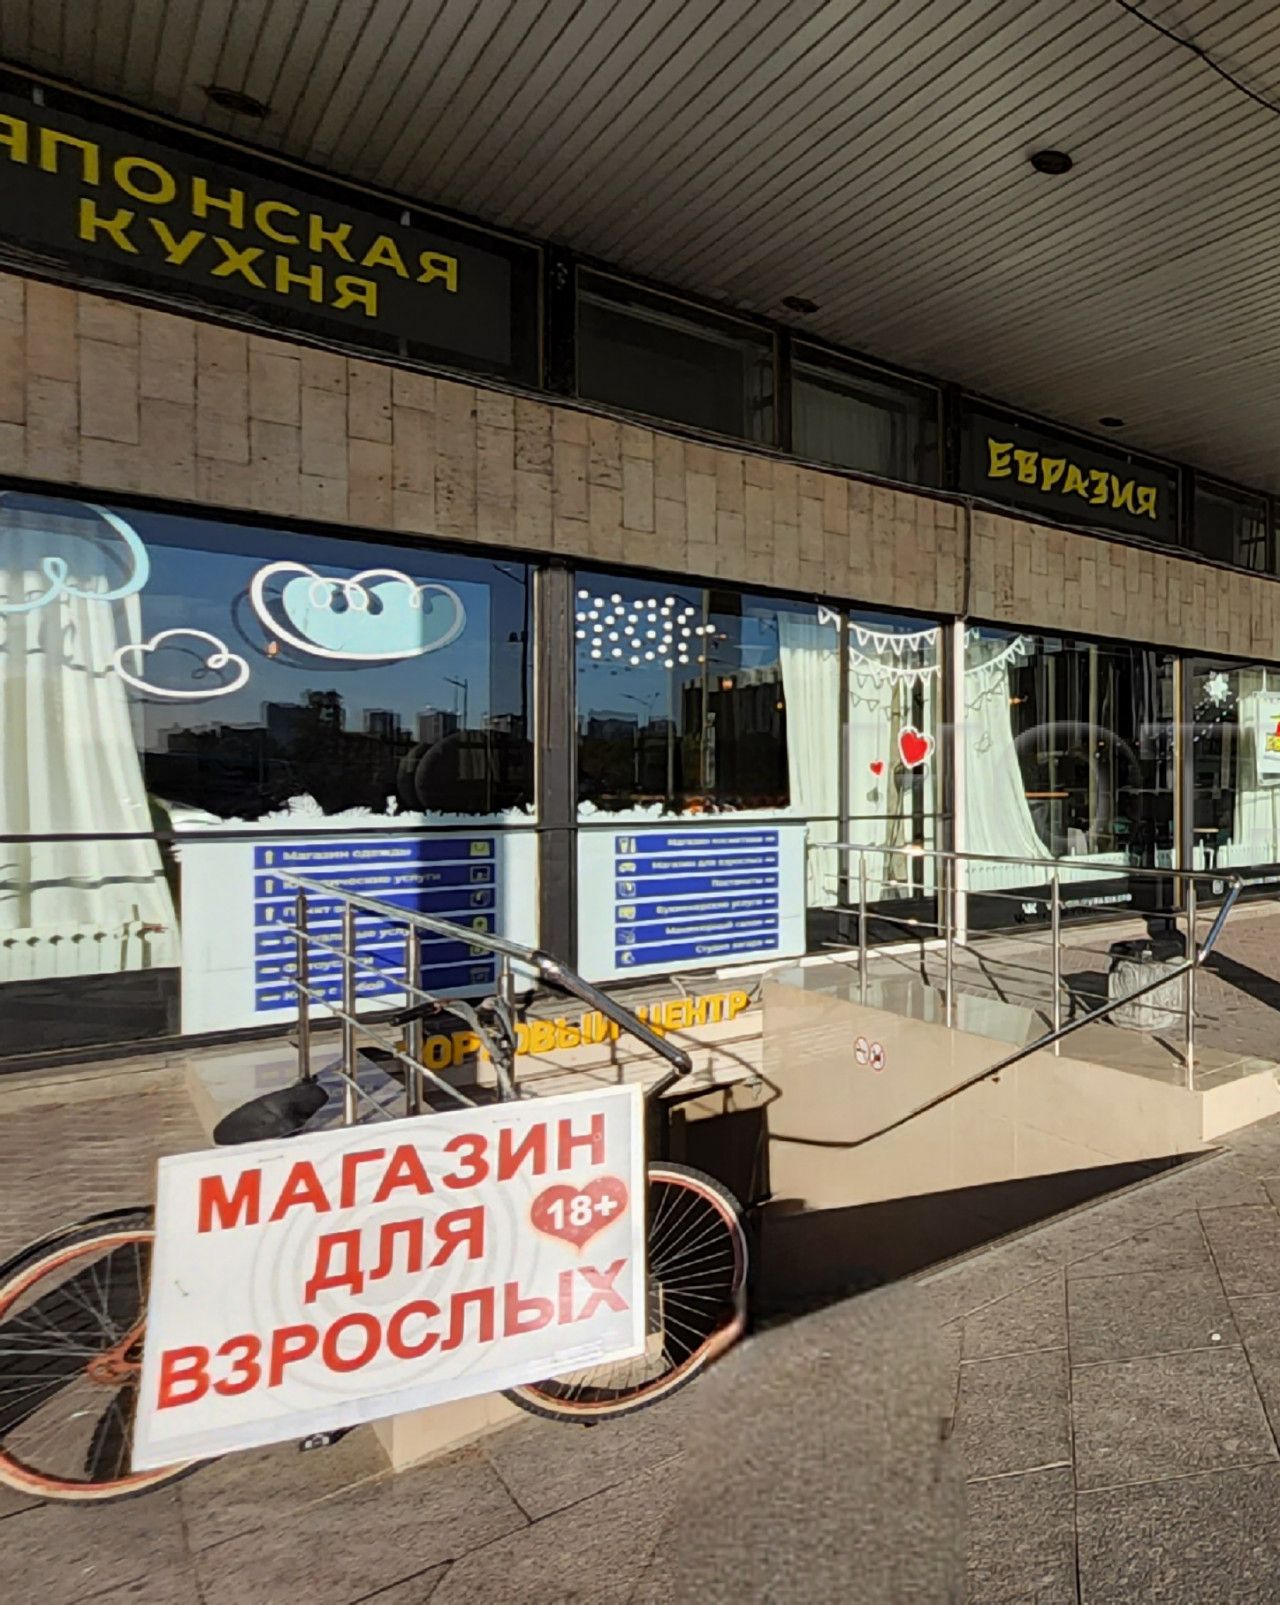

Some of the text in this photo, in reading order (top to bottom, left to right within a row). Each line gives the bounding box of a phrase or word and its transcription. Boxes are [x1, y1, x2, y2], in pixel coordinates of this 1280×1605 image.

[78, 198, 378, 318] КУХНЯ
[987, 436, 1157, 519] ЕВРАЗИЯ
[283, 847, 412, 862] Магазин одежды
[394, 871, 442, 886] услуги
[397, 990, 749, 1070] ОРОВЫЙ ЦЕНТР
[197, 1113, 606, 1234] МАГАЗИН
[546, 1193, 619, 1231] 18+
[303, 1205, 486, 1304] ДЛЯ
[156, 1258, 629, 1411] ВЗРОСЛЫХ
